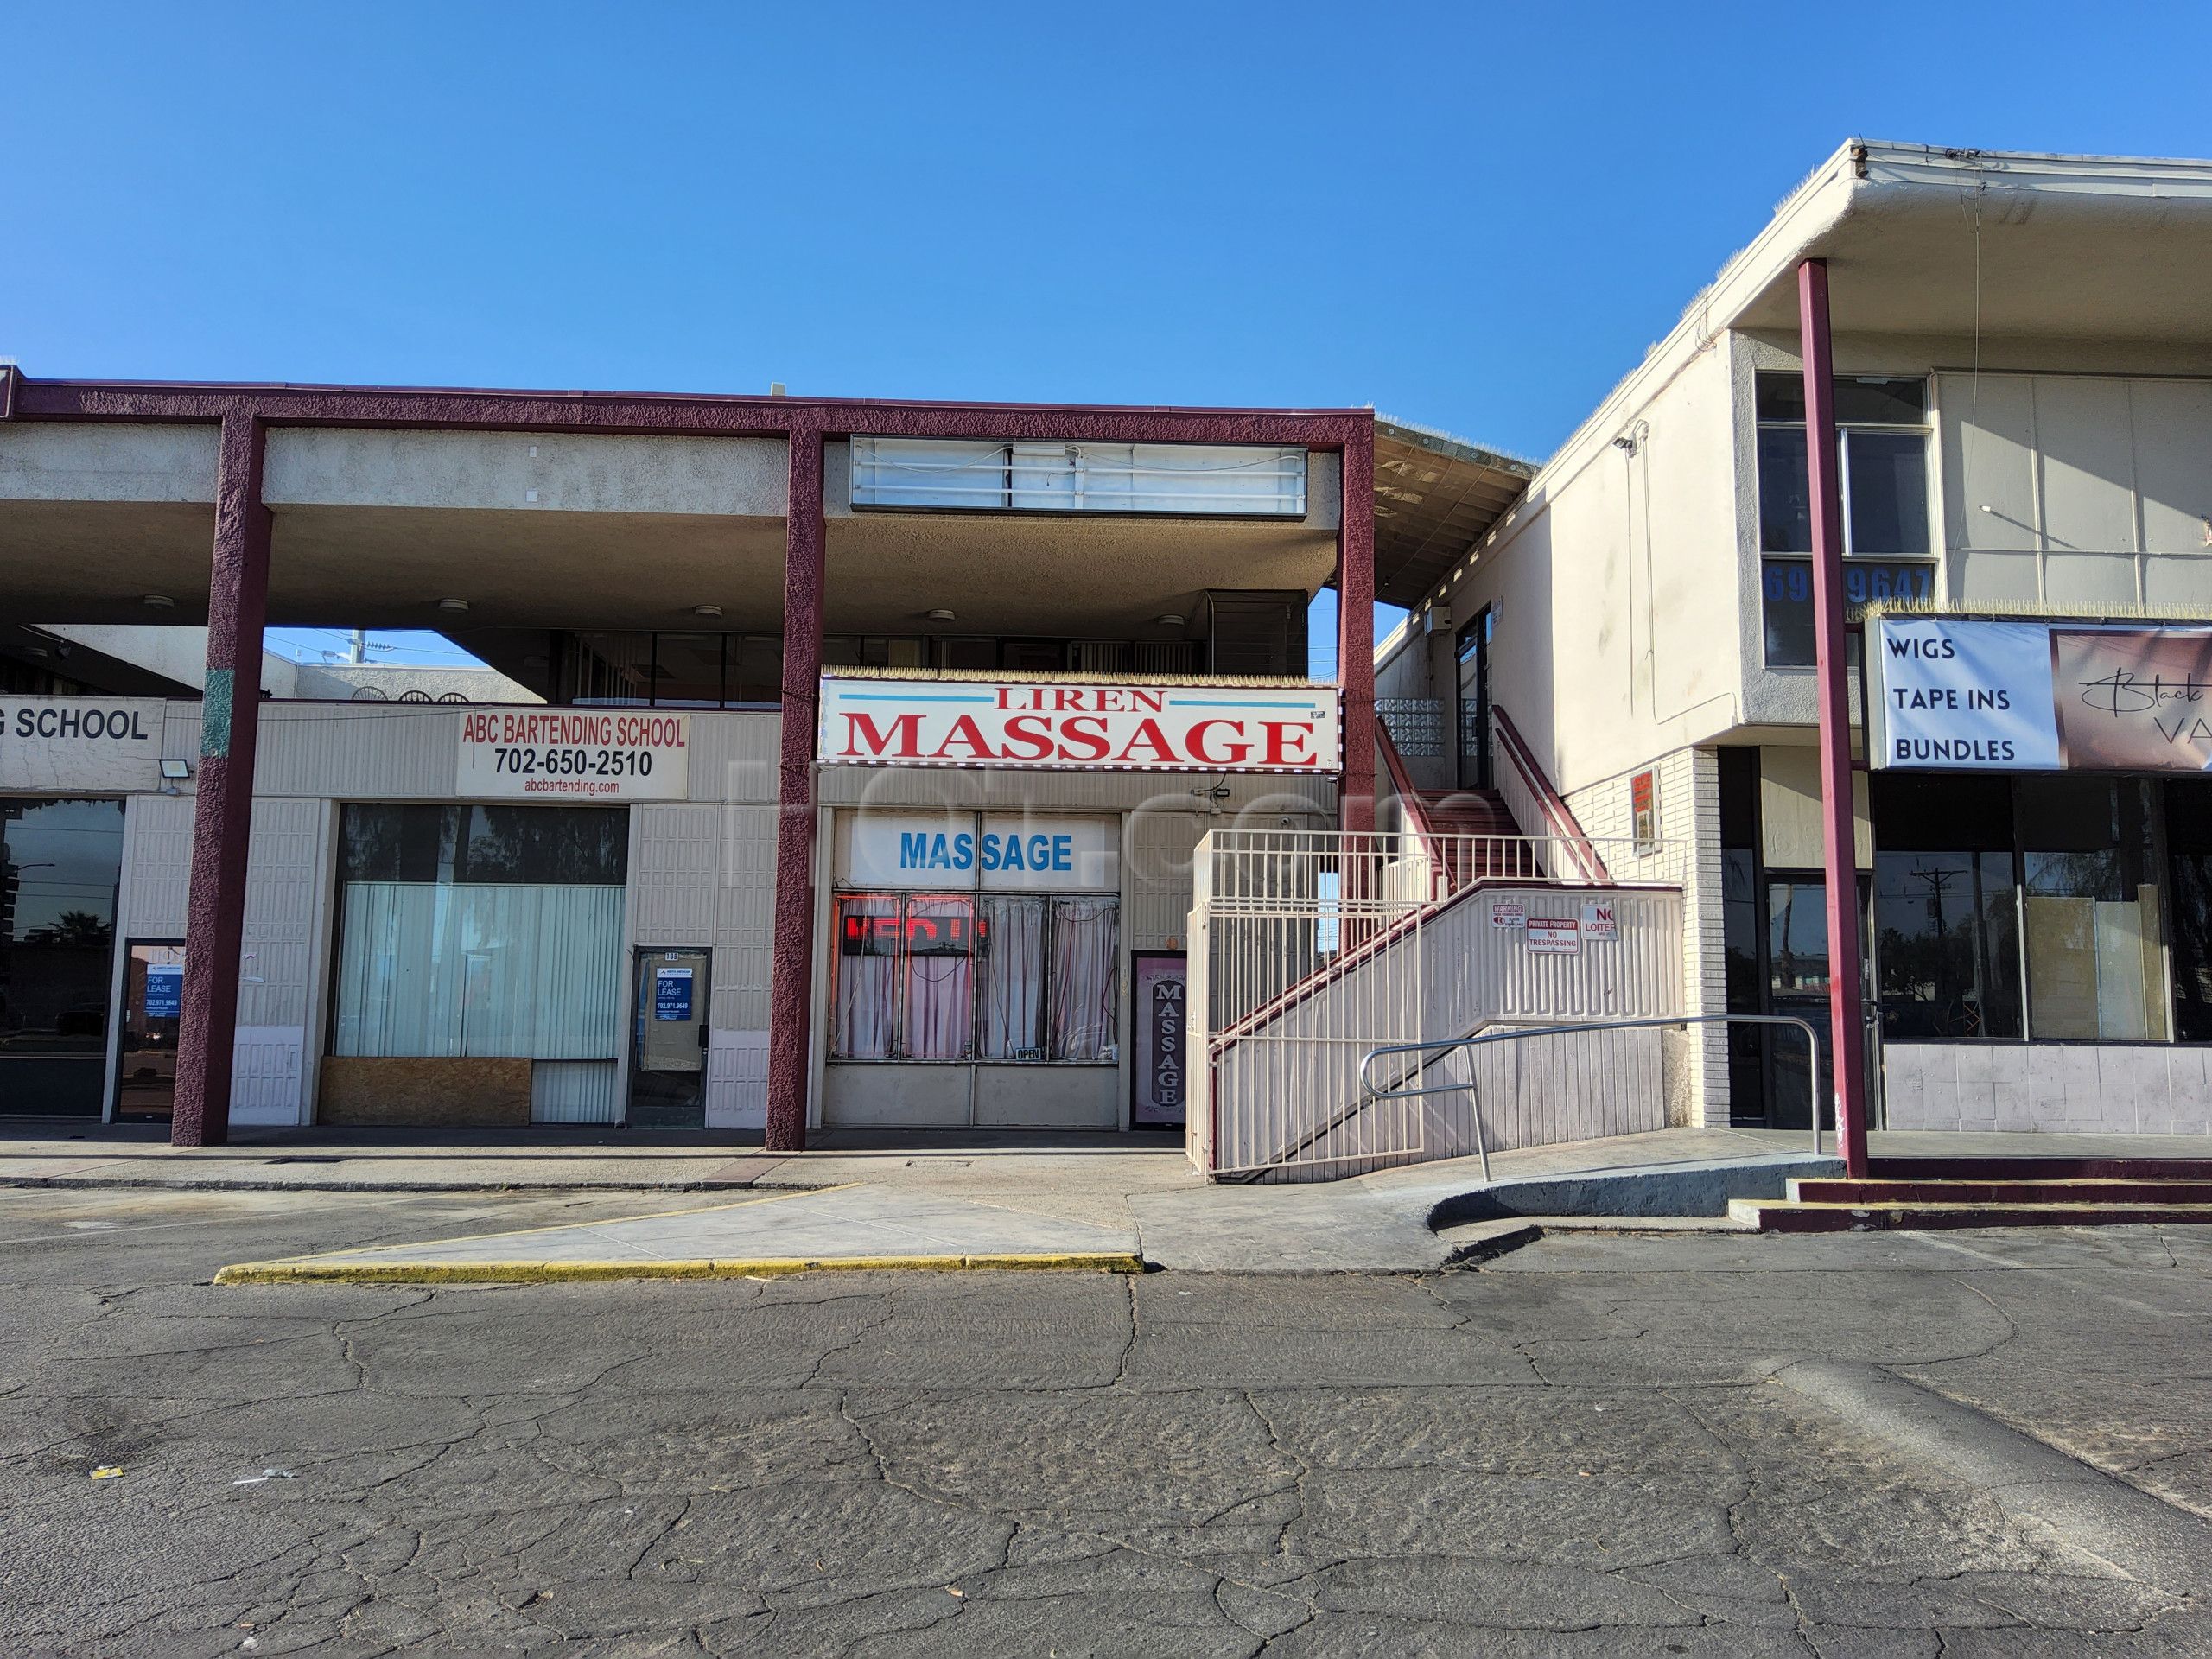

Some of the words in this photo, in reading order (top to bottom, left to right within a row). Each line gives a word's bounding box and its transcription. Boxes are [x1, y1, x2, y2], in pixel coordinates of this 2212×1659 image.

[1886, 638, 1955, 660] WIGS
[994, 687, 1168, 714] LIREN
[1892, 688, 1959, 710] TAPE
[1968, 689, 2011, 711] INS
[2079, 667, 2212, 718] Black
[16, 708, 149, 741] SCHOOL
[462, 714, 499, 744] ABC
[504, 715, 612, 746] BARTENDING
[617, 716, 685, 747] SCHOOL
[839, 712, 1317, 766] MASSAGE
[1896, 738, 2015, 762] BUNDLES
[494, 747, 653, 777] 702-650-2510
[524, 778, 620, 796] abcbartending.com
[899, 832, 1072, 872] MASSAGE
[1549, 920, 1576, 929] PROPERTY
[658, 988, 682, 996] LEASE
[1017, 1049, 1039, 1060] OPEN
[1155, 984, 1182, 1104] MASSAGE
